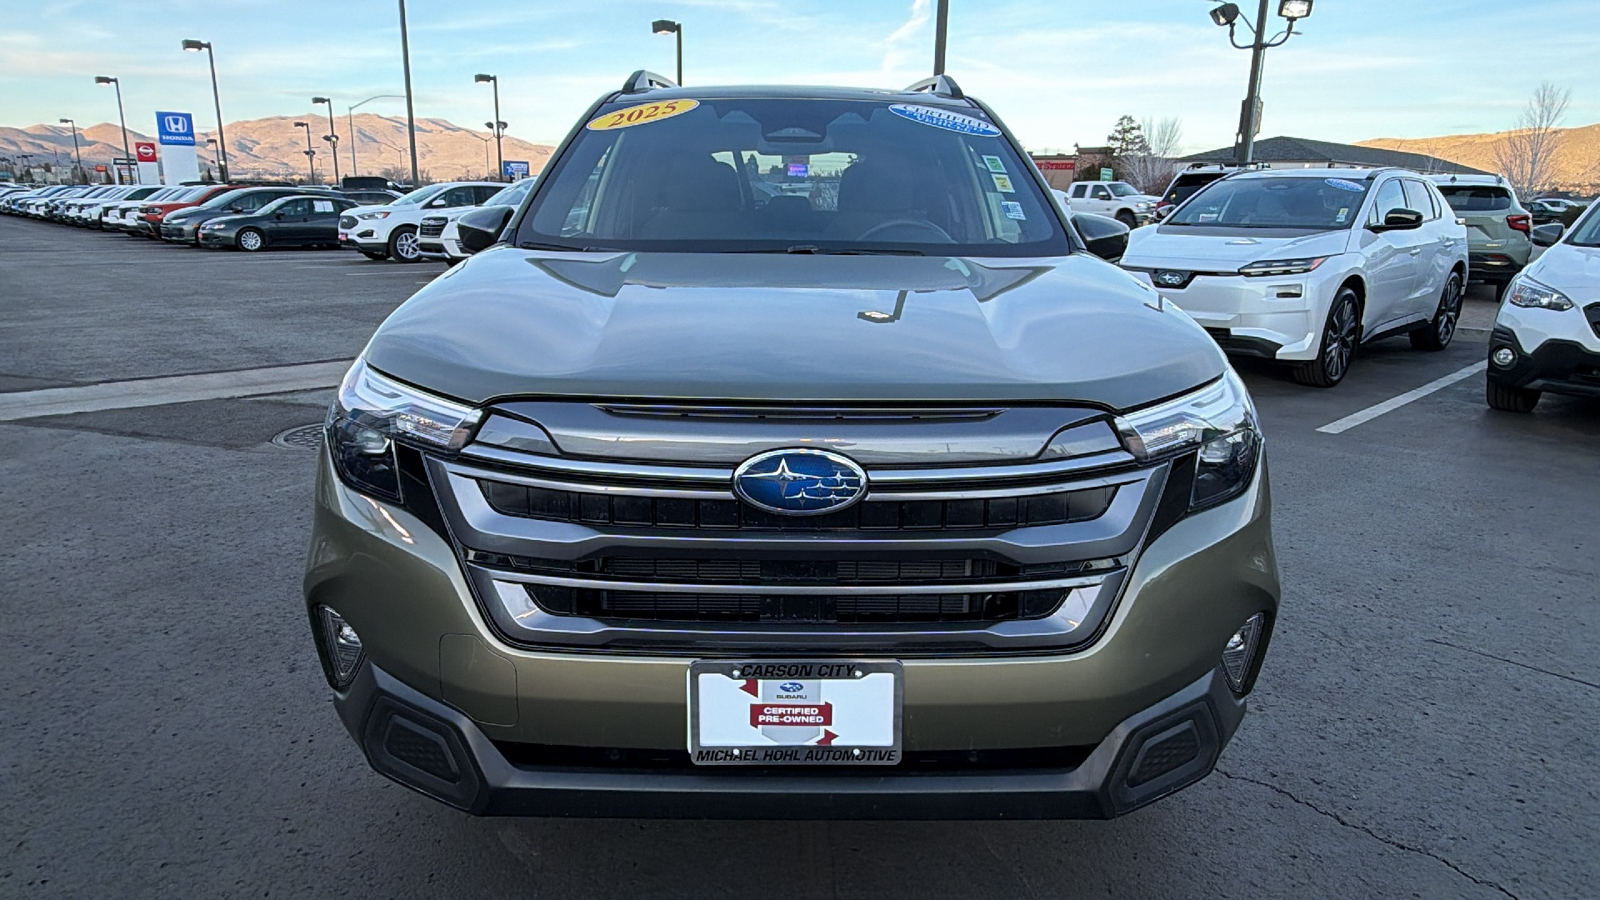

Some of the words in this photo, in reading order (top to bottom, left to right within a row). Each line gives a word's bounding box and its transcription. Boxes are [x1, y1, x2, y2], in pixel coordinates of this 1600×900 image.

[608, 101, 679, 128] 2025
[903, 104, 989, 129] CERTIFIED
[741, 664, 813, 677] CARSON
[817, 664, 856, 677] CITY
[763, 706, 819, 715] CERTIFIED
[758, 715, 824, 723] PRE-OWNED
[696, 749, 759, 761] MICHAEL
[762, 749, 801, 761] HOHL
[804, 749, 897, 761] AUTOMOTIVE
